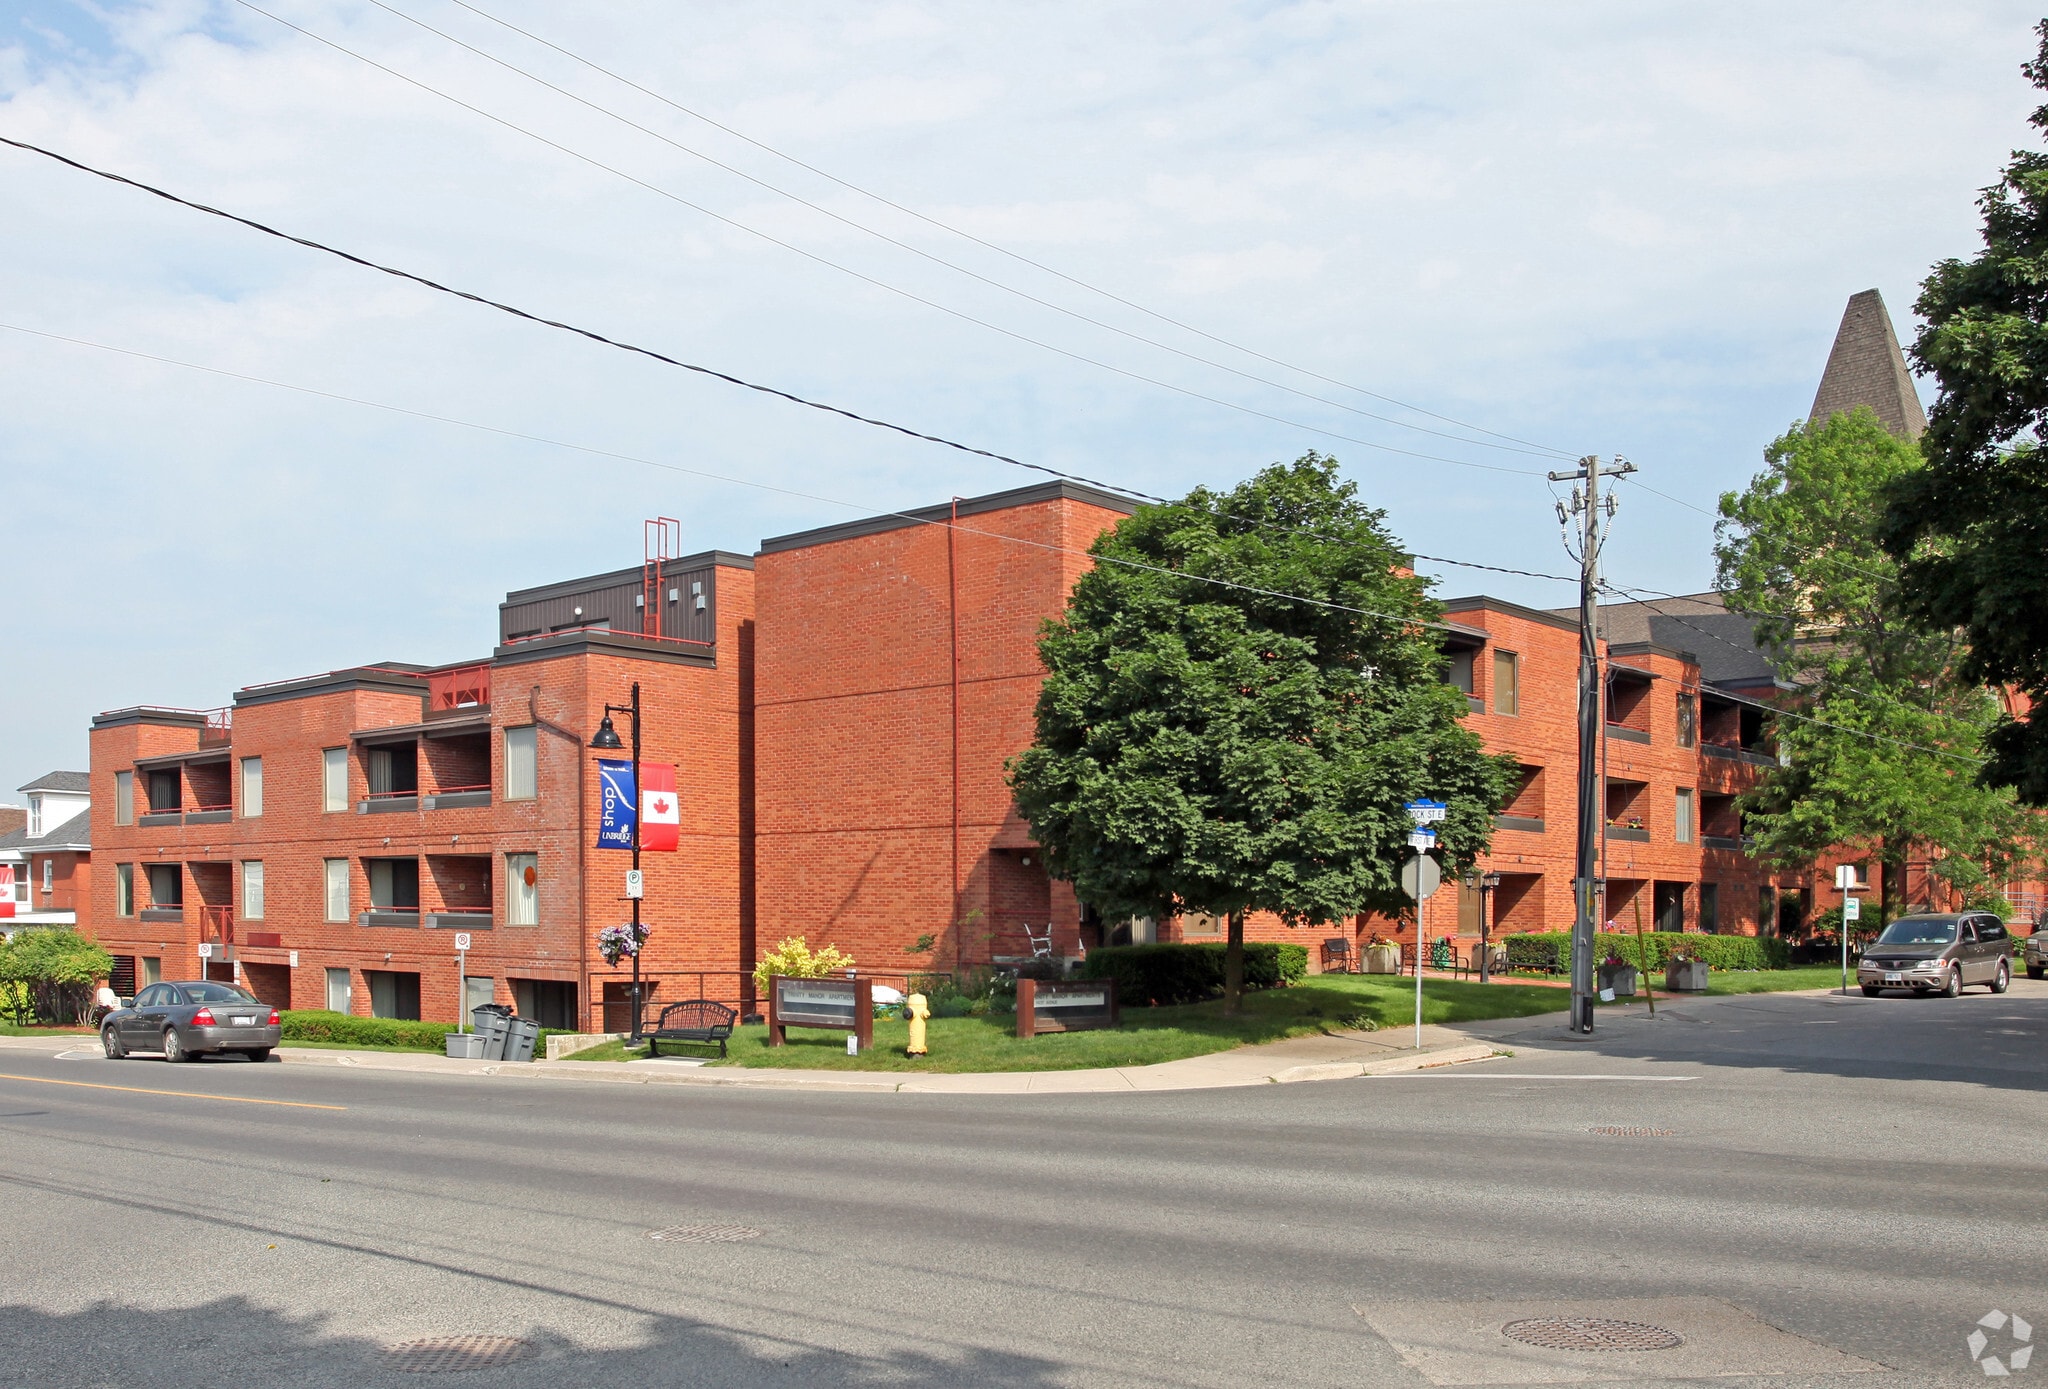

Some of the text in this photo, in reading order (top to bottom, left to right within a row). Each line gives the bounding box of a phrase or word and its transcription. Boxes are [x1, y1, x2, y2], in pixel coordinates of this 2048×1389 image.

[603, 787, 617, 827] shop
[1427, 810, 1435, 819] ST
[1438, 810, 1443, 819] E
